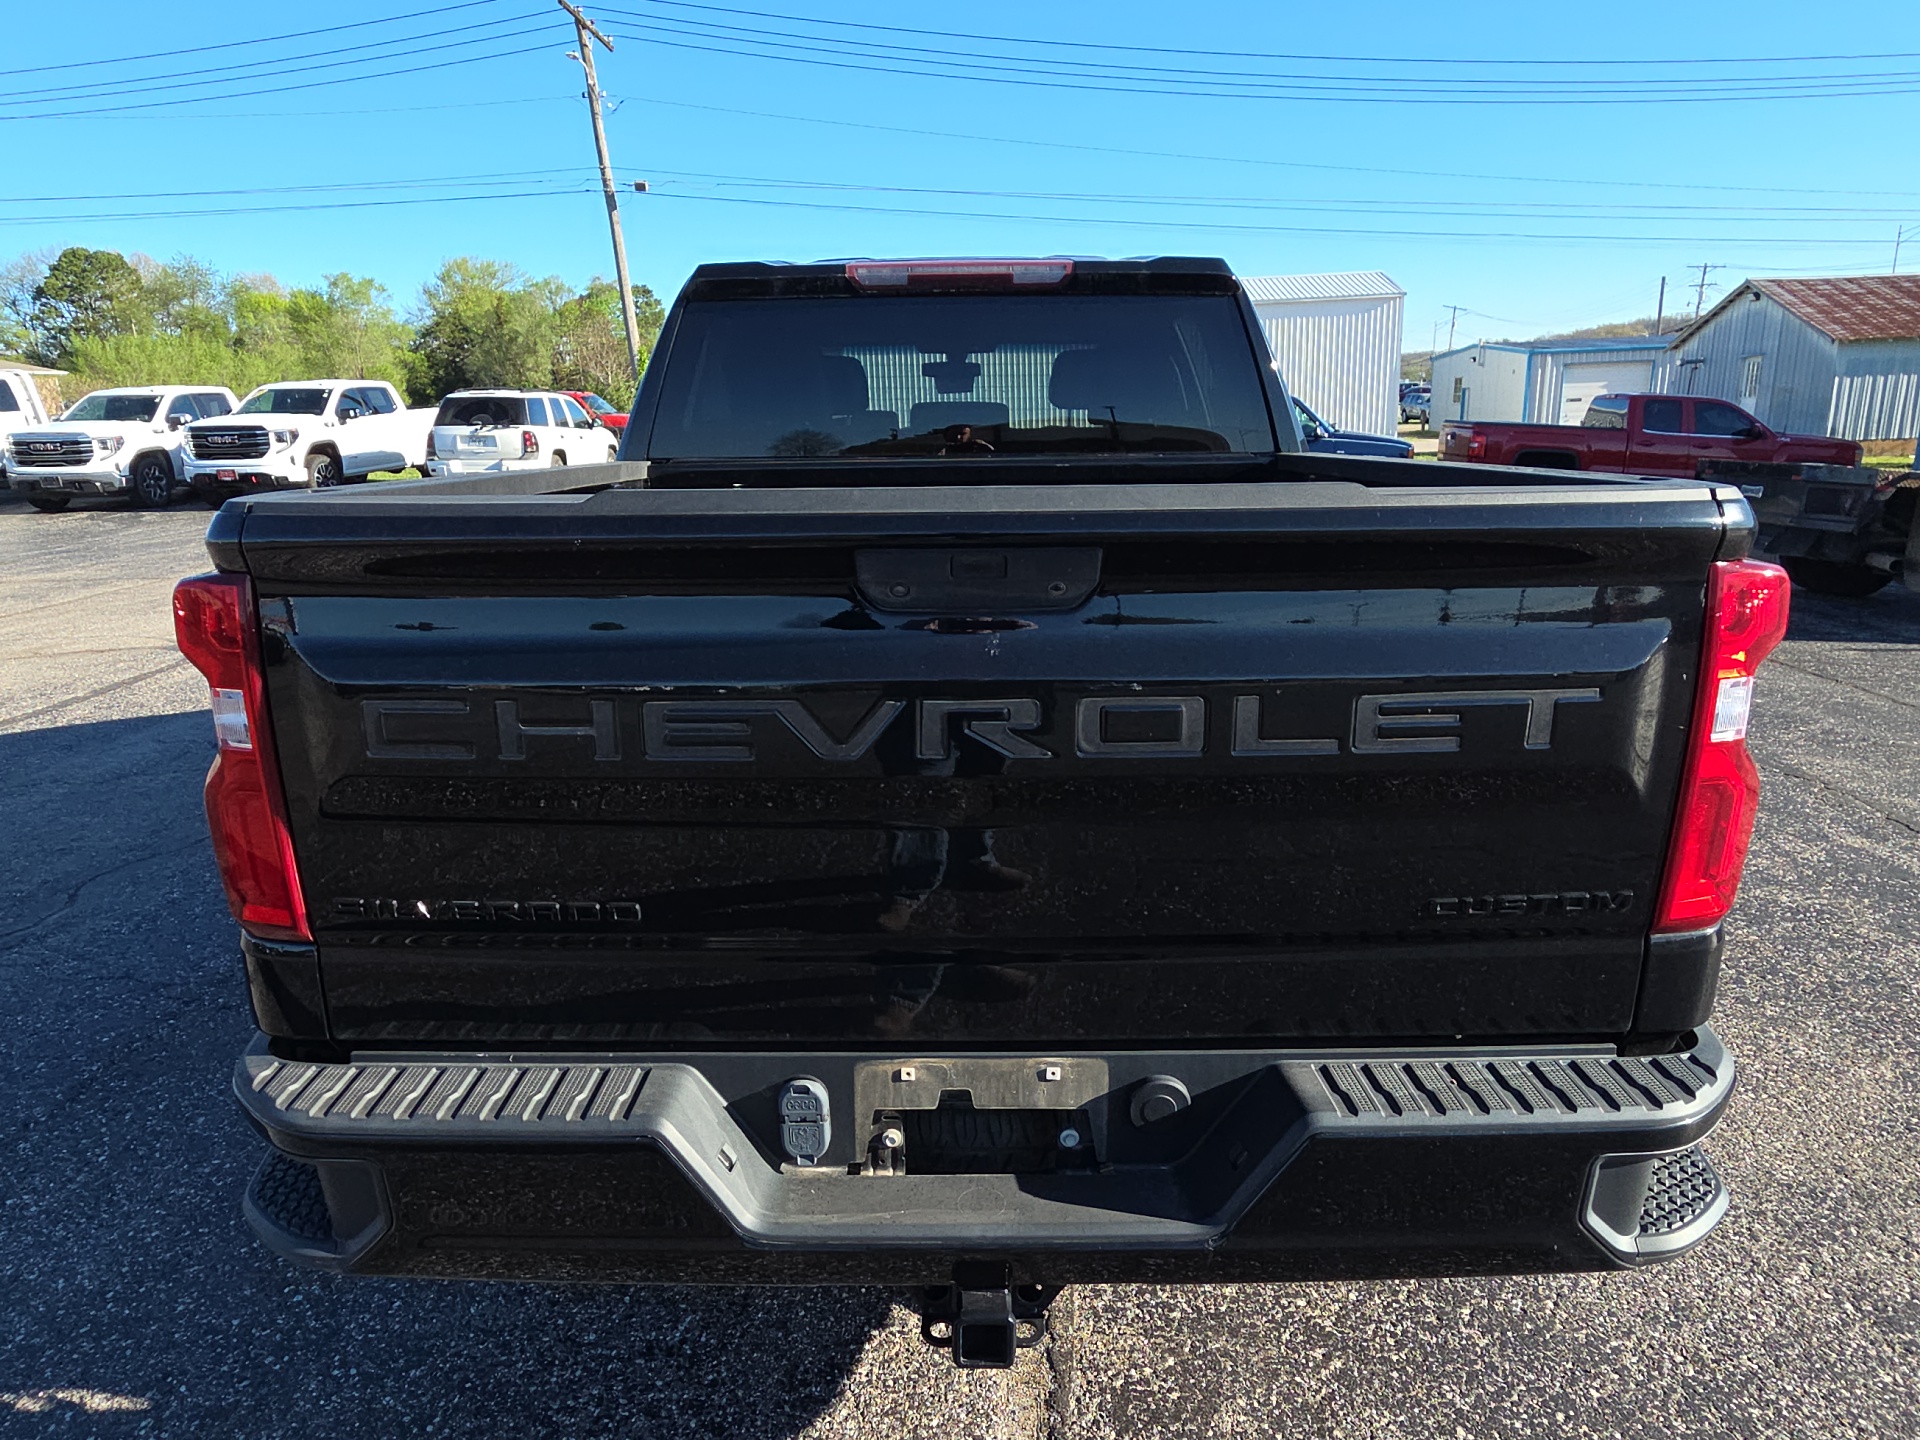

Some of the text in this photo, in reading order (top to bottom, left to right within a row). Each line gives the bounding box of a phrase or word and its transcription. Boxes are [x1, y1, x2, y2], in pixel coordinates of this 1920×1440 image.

[28, 442, 61, 451] GMC
[206, 434, 239, 444] GMC
[360, 687, 1601, 762] CHEVROLET
[333, 897, 643, 921] SILVERADO
[1428, 889, 1635, 916] CUSTOM
